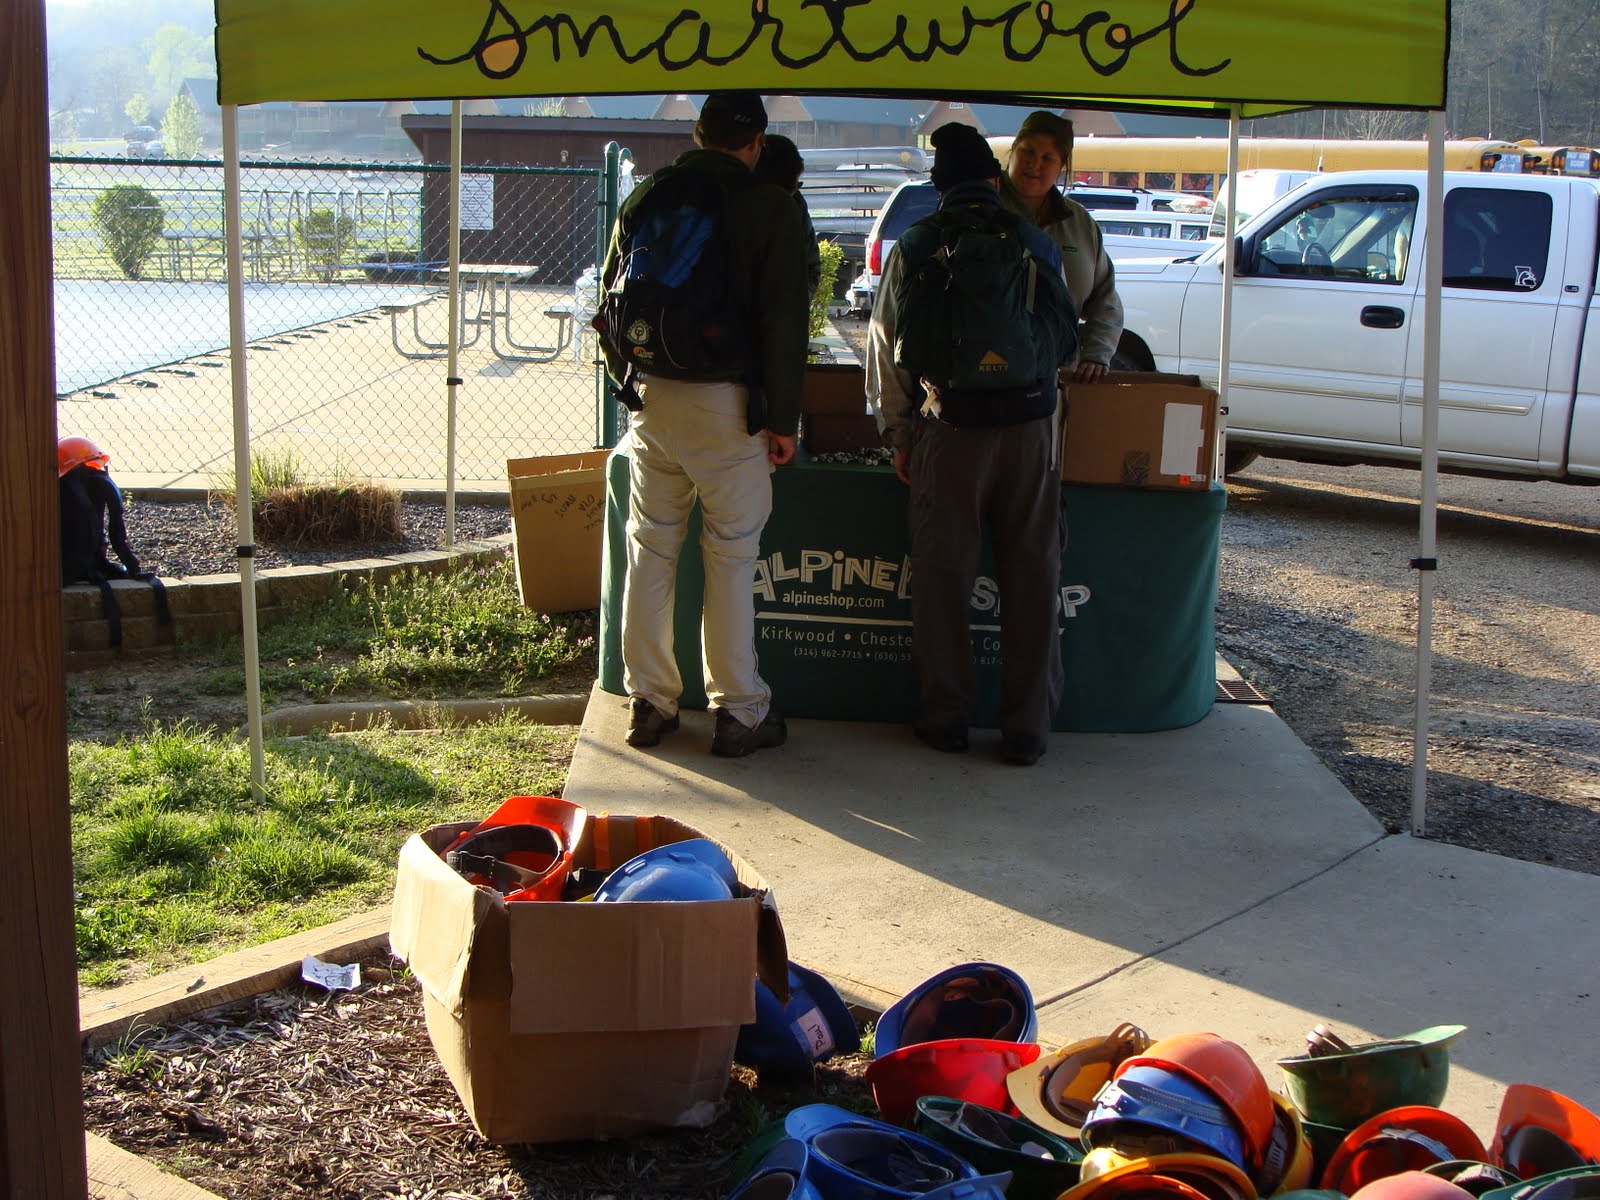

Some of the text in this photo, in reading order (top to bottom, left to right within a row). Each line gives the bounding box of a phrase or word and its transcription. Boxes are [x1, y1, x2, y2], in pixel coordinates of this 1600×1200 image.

[418, 0, 1231, 79] smartwool
[782, 590, 885, 609] alpineshop.com
[761, 626, 913, 646] Kirkwood Cheste
[794, 647, 818, 657] (314)
[821, 649, 863, 660] 962-7715
[807, 1024, 825, 1050] Paul
